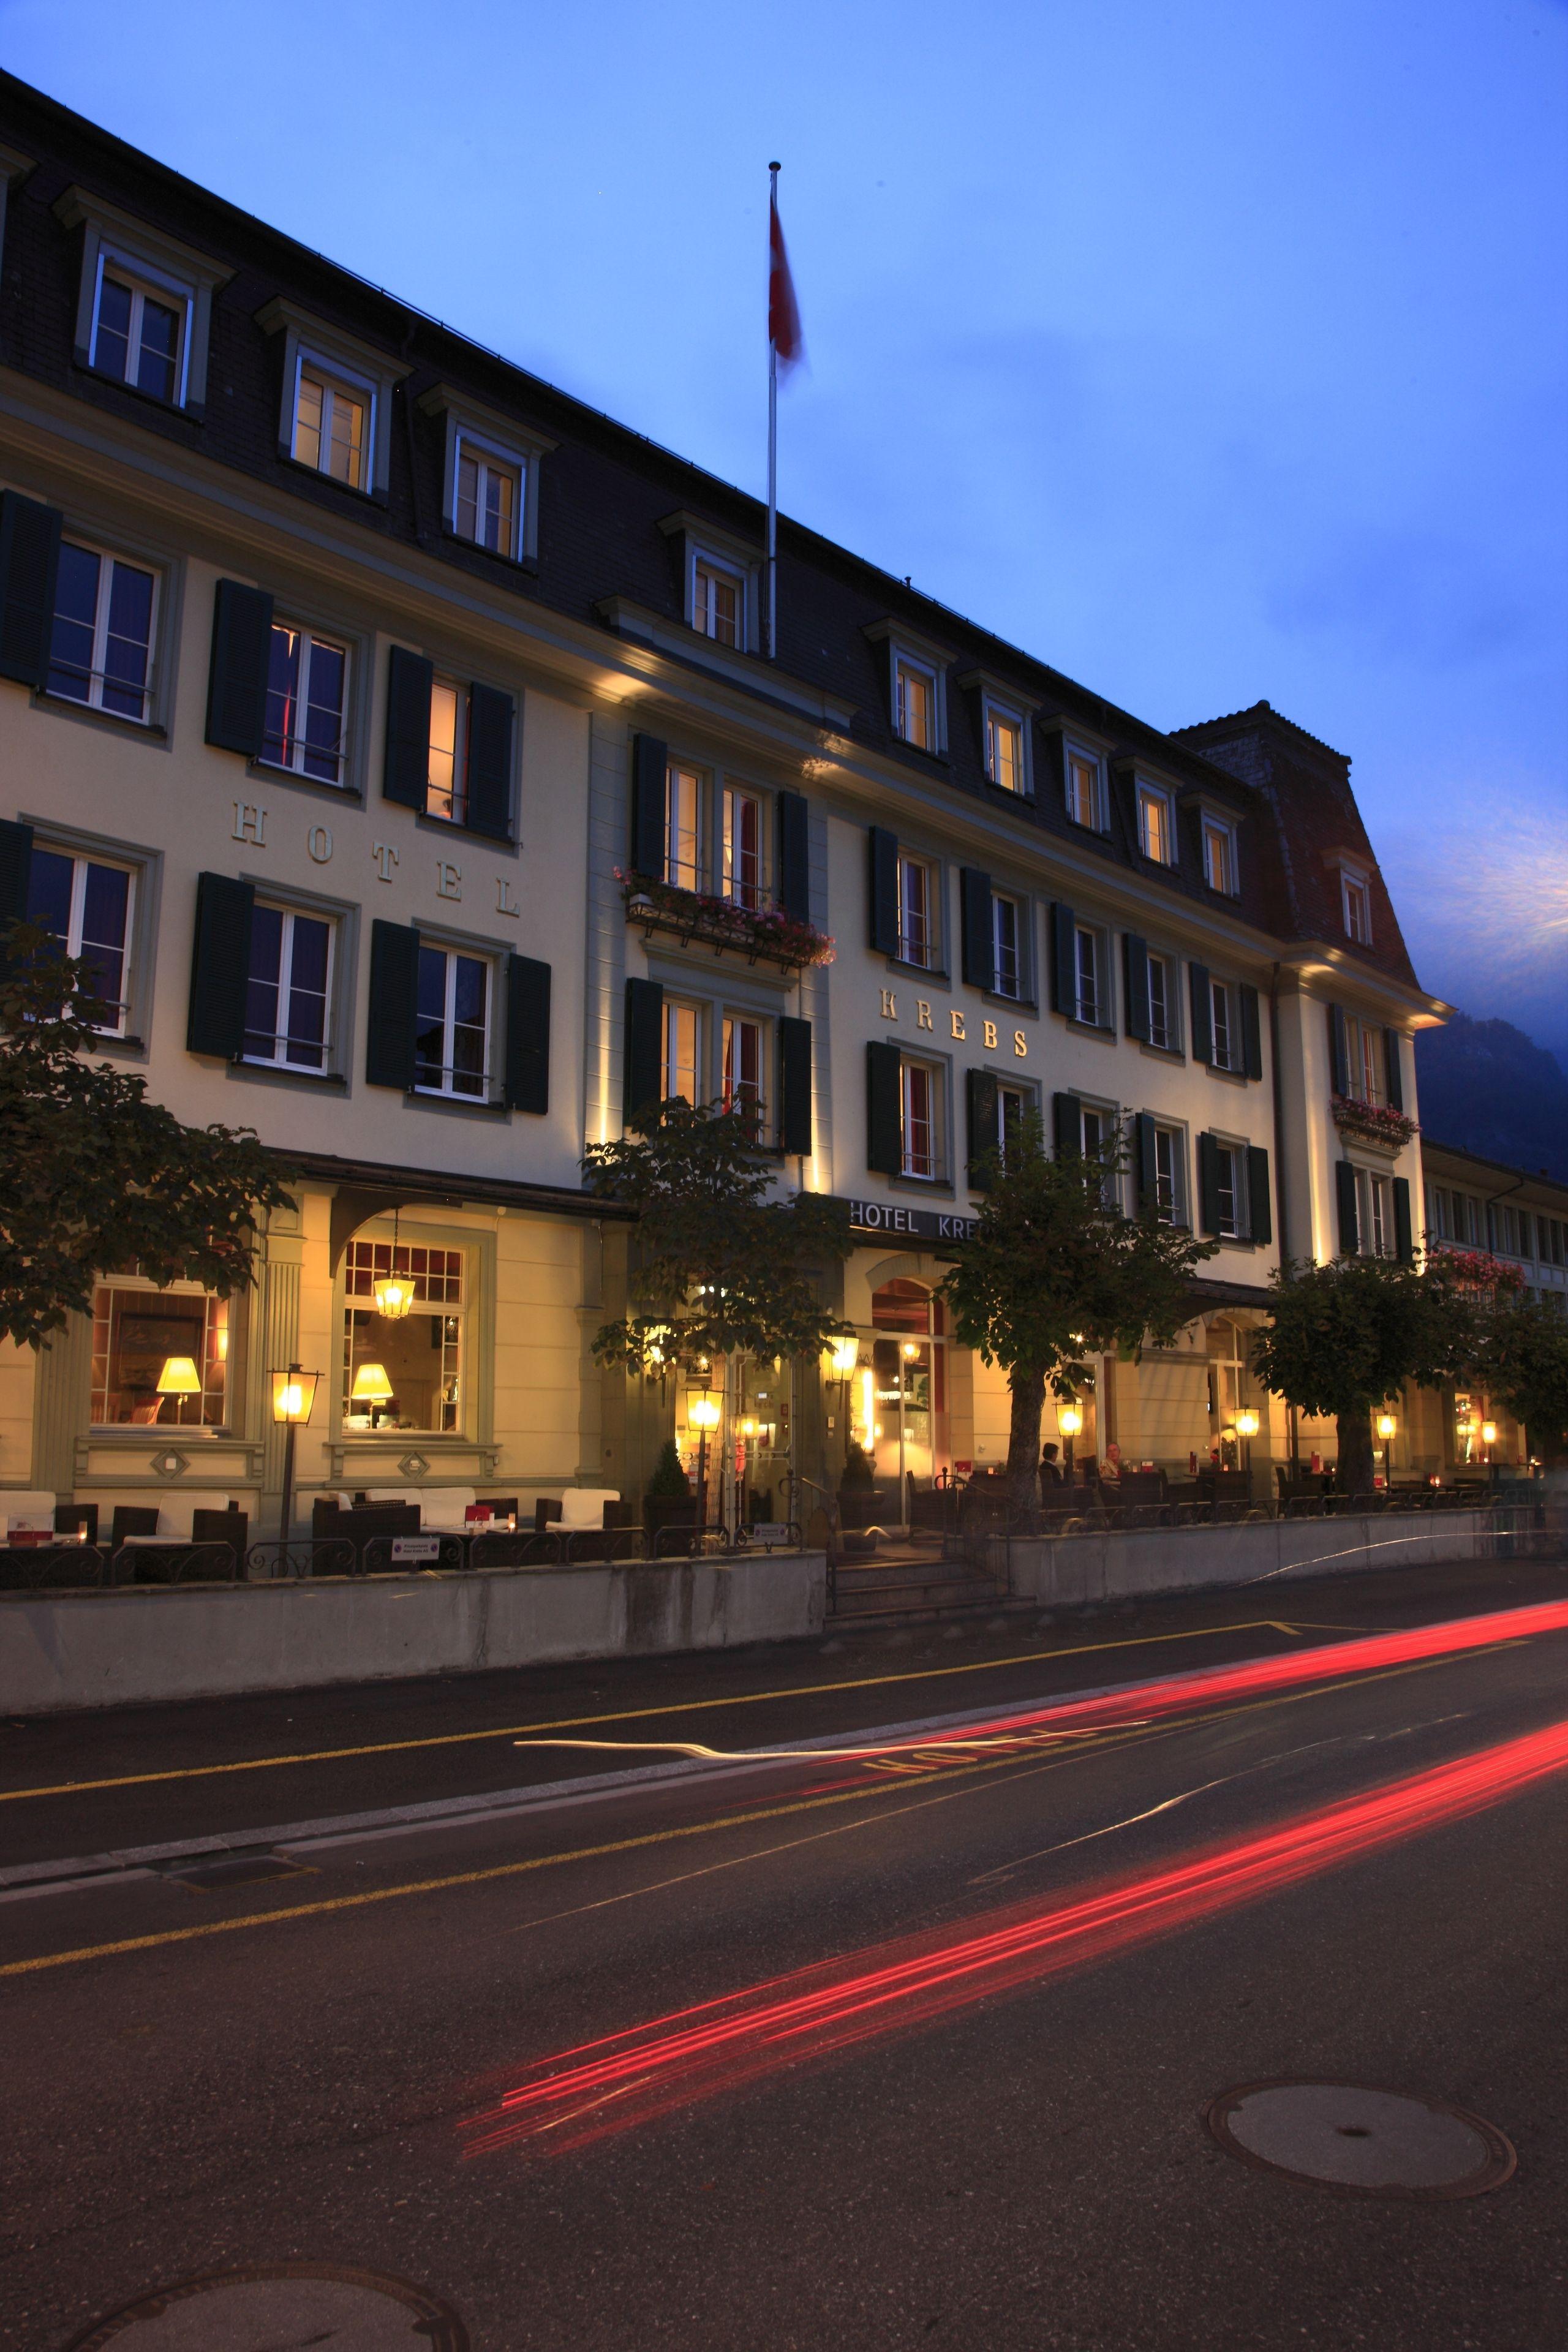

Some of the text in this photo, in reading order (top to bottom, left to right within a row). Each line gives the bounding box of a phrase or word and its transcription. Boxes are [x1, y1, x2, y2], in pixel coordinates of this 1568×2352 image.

[231, 800, 1028, 1057] HOTEL KREBS
[850, 1201, 919, 1233] HOTEL
